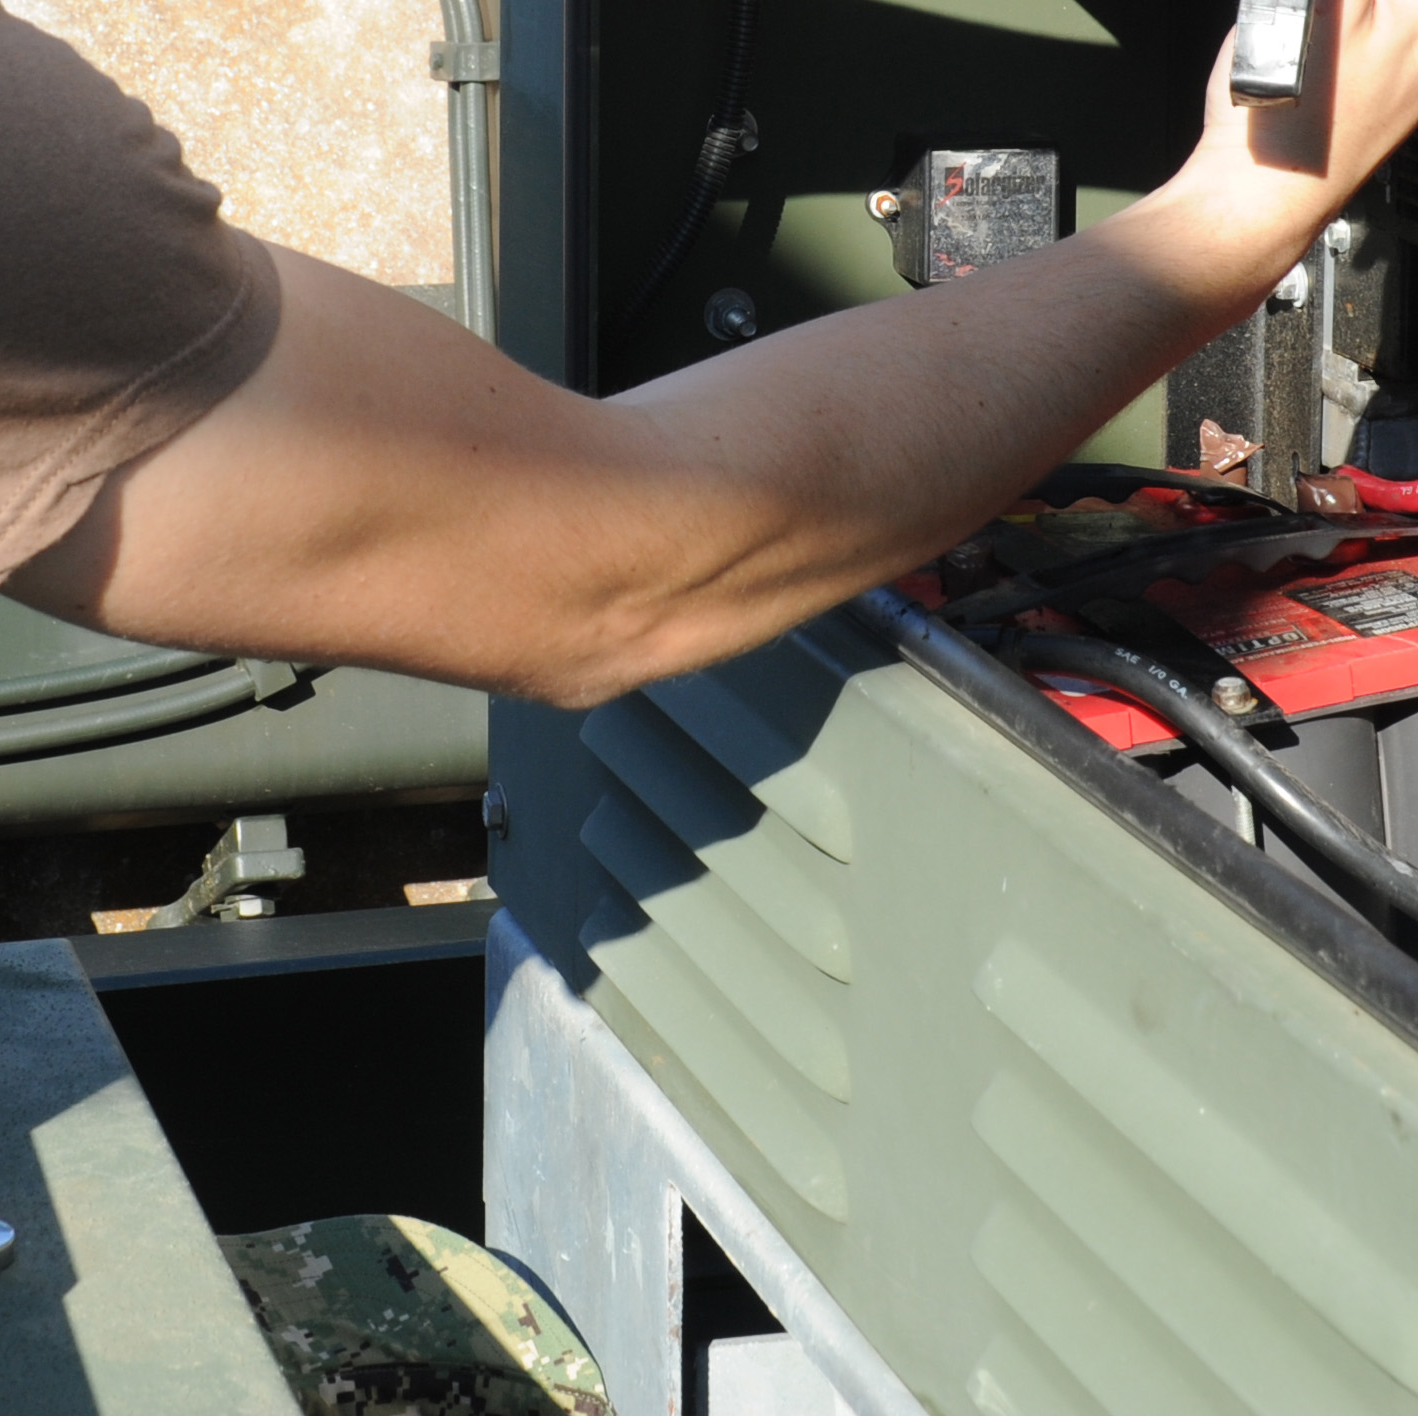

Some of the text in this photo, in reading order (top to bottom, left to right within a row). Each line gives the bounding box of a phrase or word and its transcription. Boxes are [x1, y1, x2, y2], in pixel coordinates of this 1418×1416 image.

[937, 161, 1046, 208] Solargizer
[1215, 632, 1299, 656] OPTIM
[1114, 647, 1141, 665] SAE
[1148, 665, 1167, 680] 1/0
